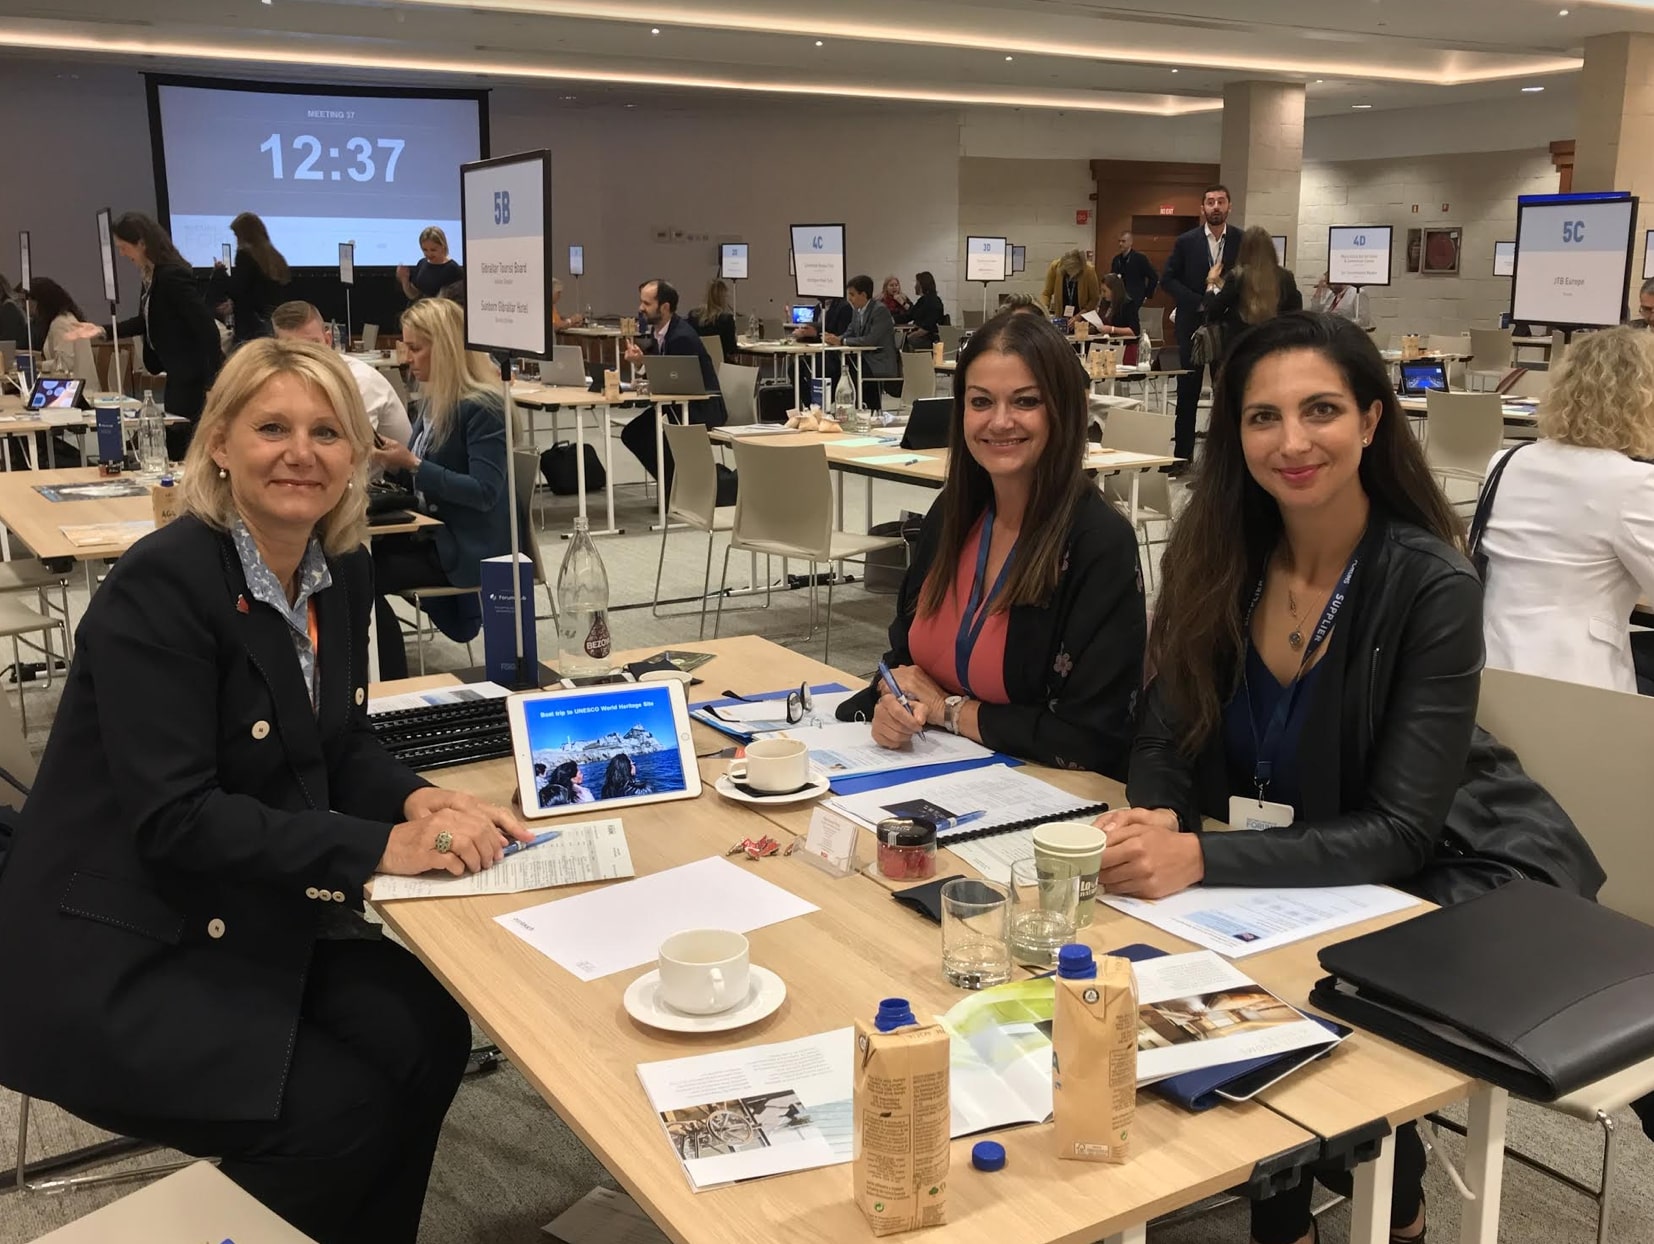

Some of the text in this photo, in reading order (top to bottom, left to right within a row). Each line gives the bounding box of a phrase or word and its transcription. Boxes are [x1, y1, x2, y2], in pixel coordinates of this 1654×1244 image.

[307, 110, 344, 119] MEETING
[260, 133, 405, 182] 12:37
[494, 190, 511, 225] 5B
[1562, 220, 1585, 243] 5C
[812, 235, 823, 249] 4C
[1353, 235, 1366, 246] 4D
[481, 262, 498, 274] Gibraltar
[514, 261, 527, 274] Board
[1553, 277, 1585, 287] JTB Europe
[1314, 593, 1345, 642] SUPPLIER
[555, 709, 565, 717] trip
[574, 706, 600, 715] UNESCO
[601, 704, 618, 712] World
[618, 702, 642, 710] Heritage
